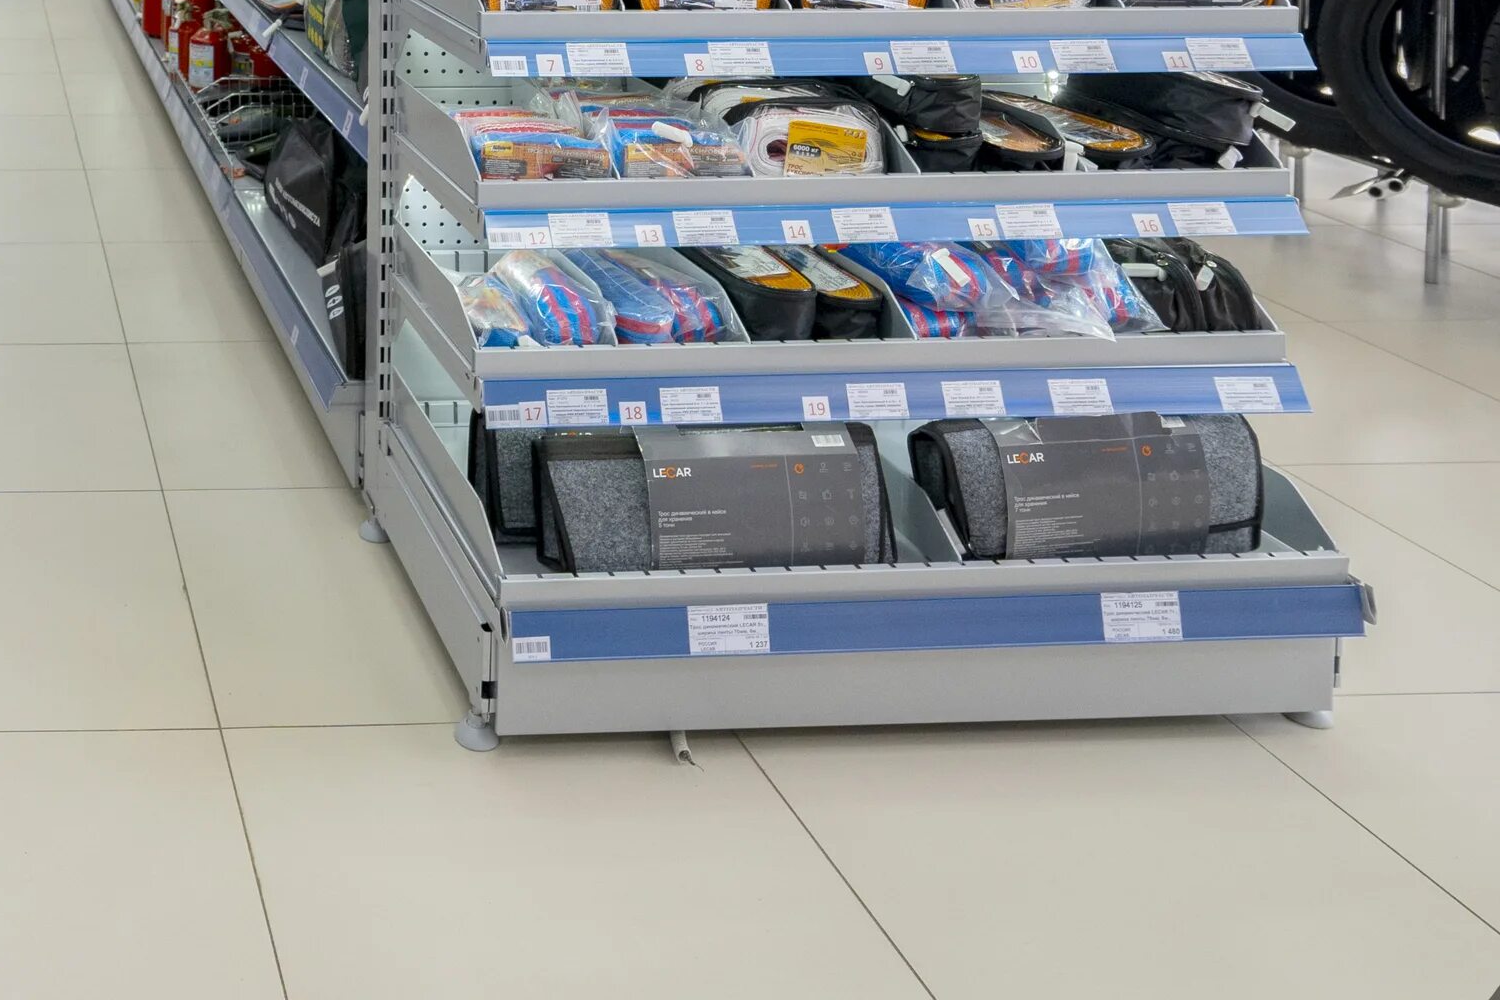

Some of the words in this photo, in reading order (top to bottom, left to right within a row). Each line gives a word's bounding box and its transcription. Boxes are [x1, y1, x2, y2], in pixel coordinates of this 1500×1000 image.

[546, 60, 555, 72] 7
[695, 59, 704, 71] 8
[874, 58, 883, 70] 9
[1020, 56, 1037, 68] 10
[1170, 56, 1187, 67] 11
[792, 144, 809, 152] 6000
[976, 224, 993, 237] 15
[1140, 219, 1159, 232] 16
[529, 232, 546, 244] 12
[642, 230, 659, 242] 13
[789, 226, 805, 238] 14
[525, 408, 542, 421] 17
[625, 406, 642, 419] 18
[809, 402, 826, 415] 19
[1007, 451, 1045, 465] LECAR
[652, 467, 692, 479] LECAR
[1114, 601, 1143, 609] 1194125
[701, 614, 730, 622] 1194124
[755, 640, 768, 648] 237
